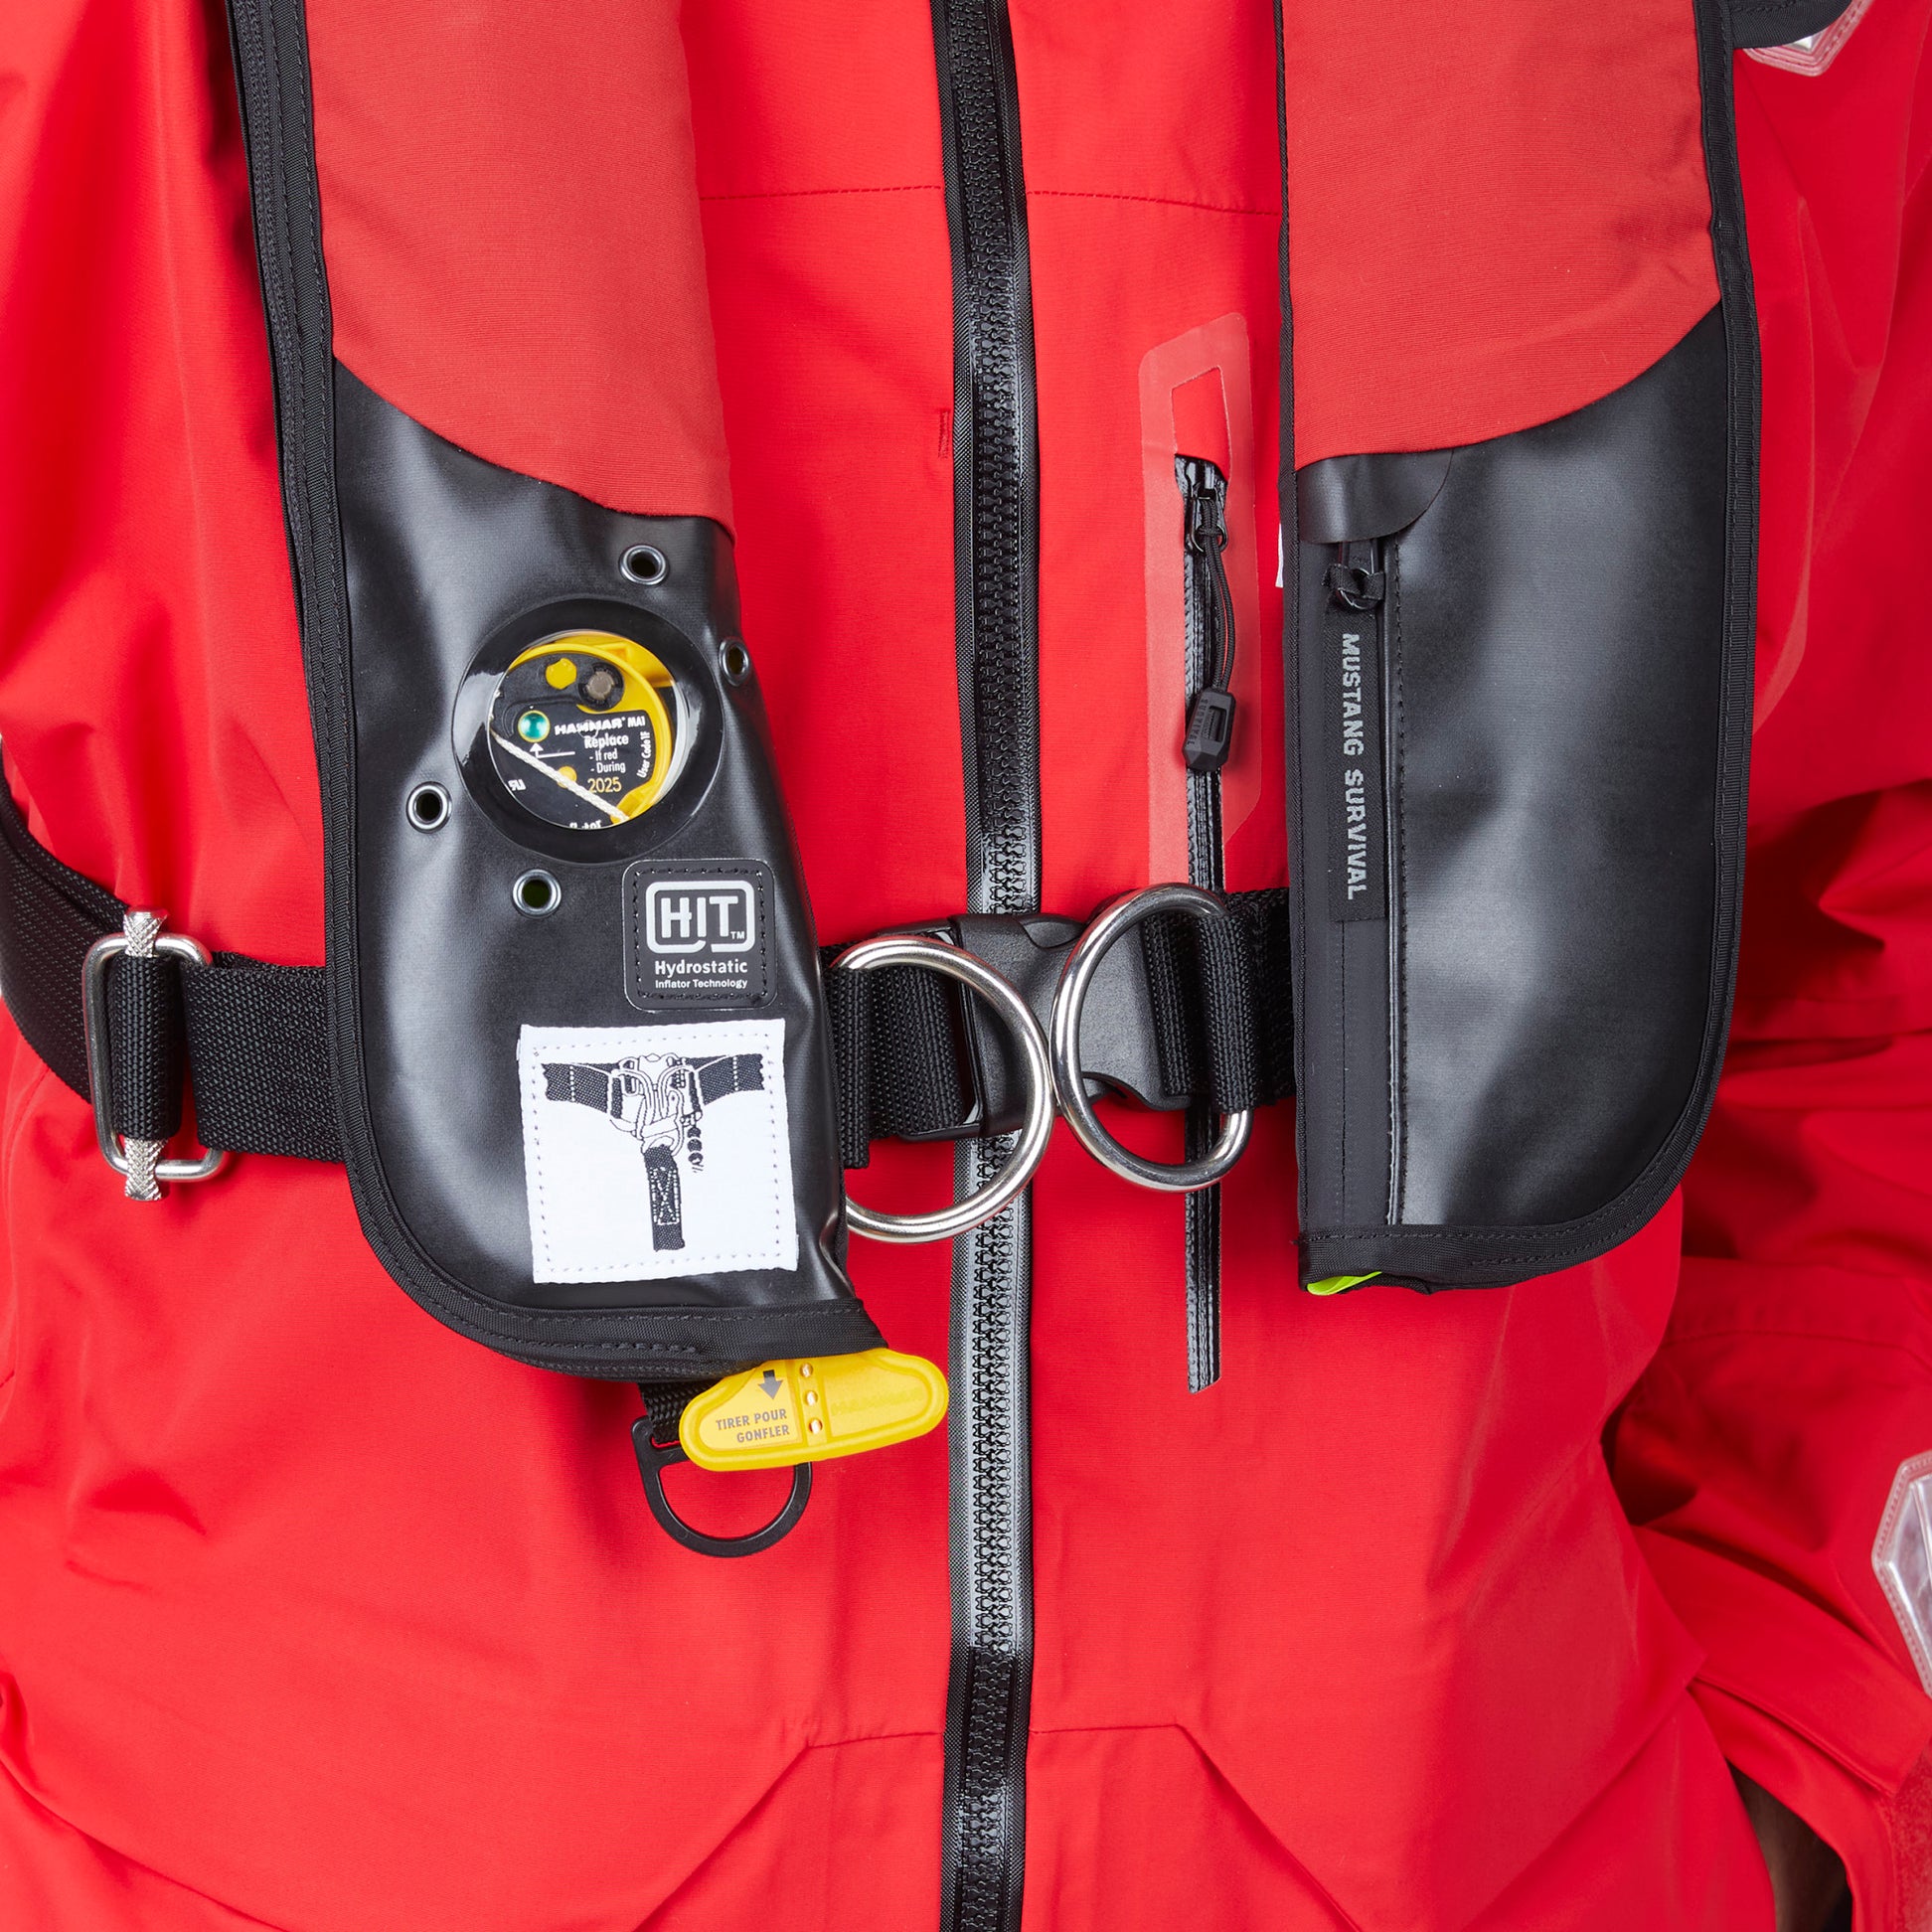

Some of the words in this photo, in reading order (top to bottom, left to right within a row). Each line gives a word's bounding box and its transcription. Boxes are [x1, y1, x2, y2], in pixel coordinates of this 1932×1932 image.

[1342, 633, 1365, 756] MUSTANG
[584, 732, 628, 748] Replace
[603, 747, 618, 760] red
[596, 761, 626, 773] During
[636, 759, 650, 778] User
[587, 776, 621, 793] 2025
[1344, 768, 1367, 900] SURVIVAL
[661, 895, 738, 938] HIT
[655, 959, 747, 977] Hydrostatic
[655, 978, 691, 989] Inflator
[693, 978, 748, 989] Technology
[716, 1415, 750, 1430] TIRER
[753, 1408, 787, 1424] POUR
[736, 1424, 790, 1443] GONFLER
